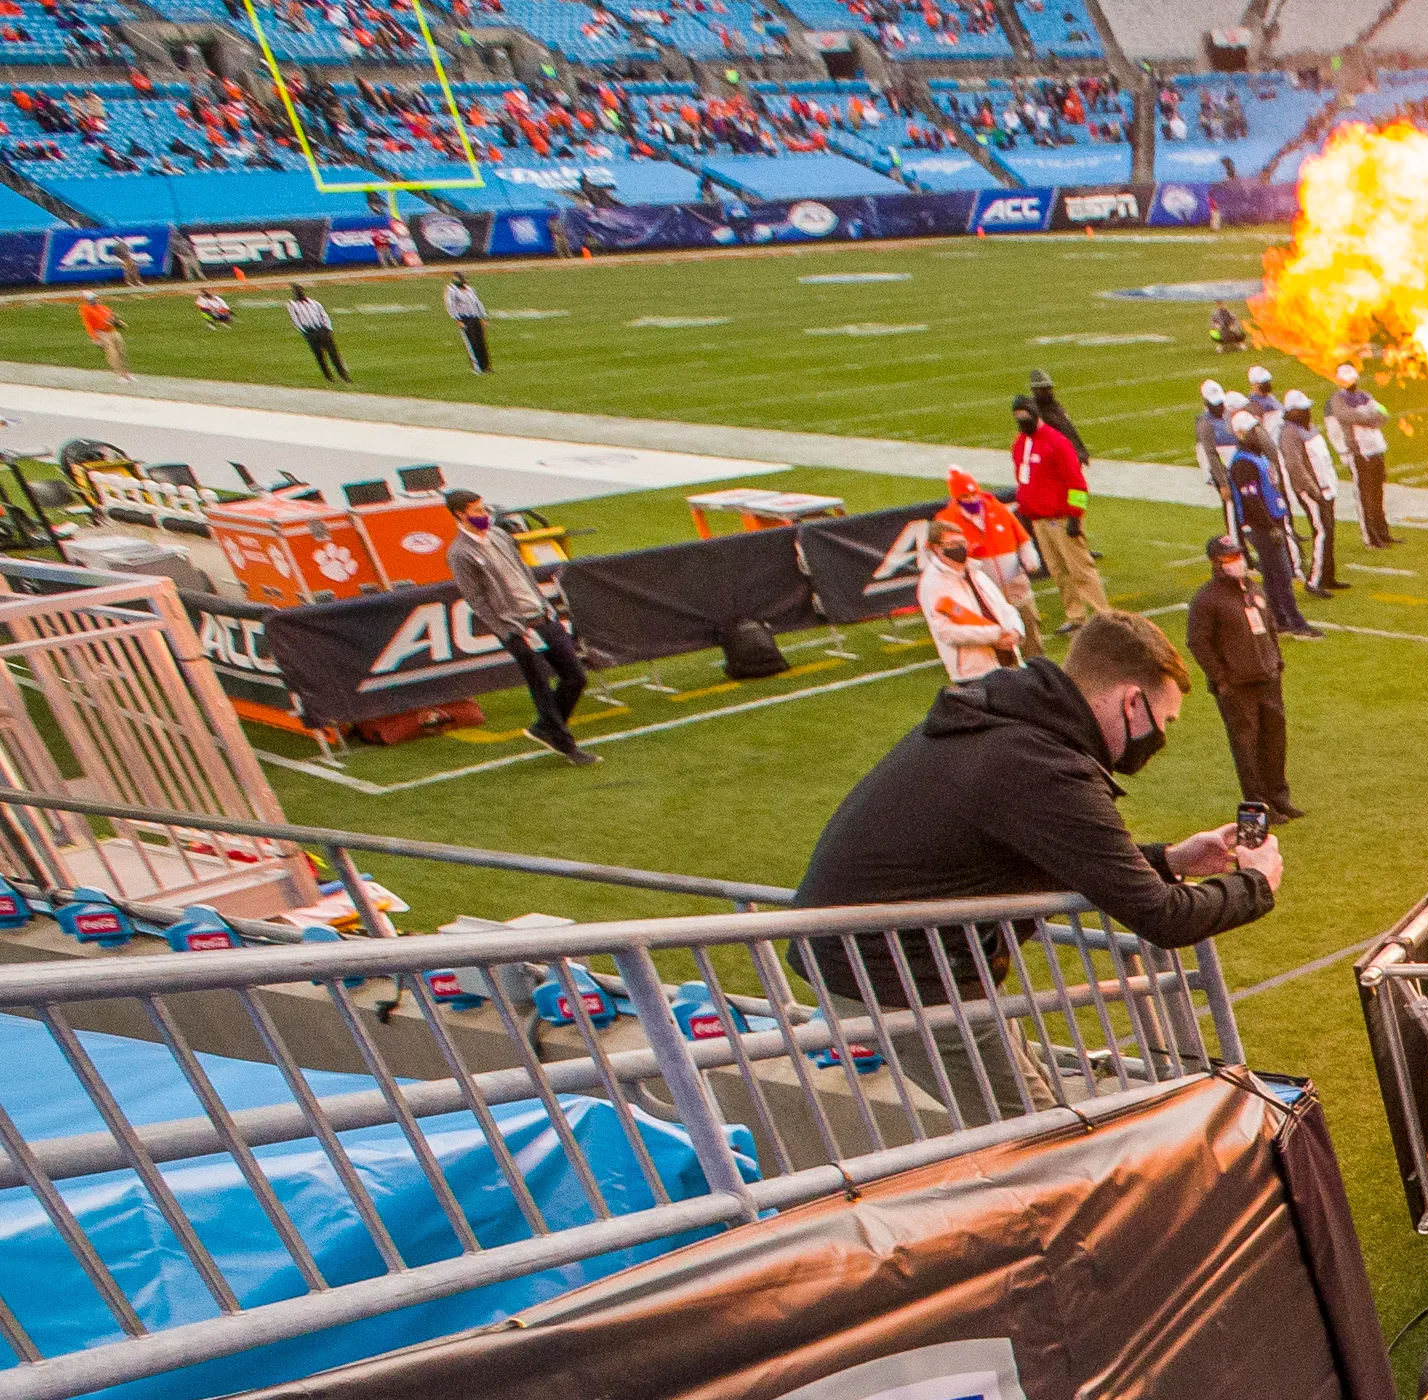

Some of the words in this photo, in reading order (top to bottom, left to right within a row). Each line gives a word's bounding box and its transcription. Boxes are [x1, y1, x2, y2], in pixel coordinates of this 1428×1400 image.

[976, 197, 1040, 224] ACC
[1064, 193, 1139, 222] ESPN
[58, 235, 153, 266] ACC
[188, 229, 303, 264] ESPN
[201, 591, 283, 675] ACC
